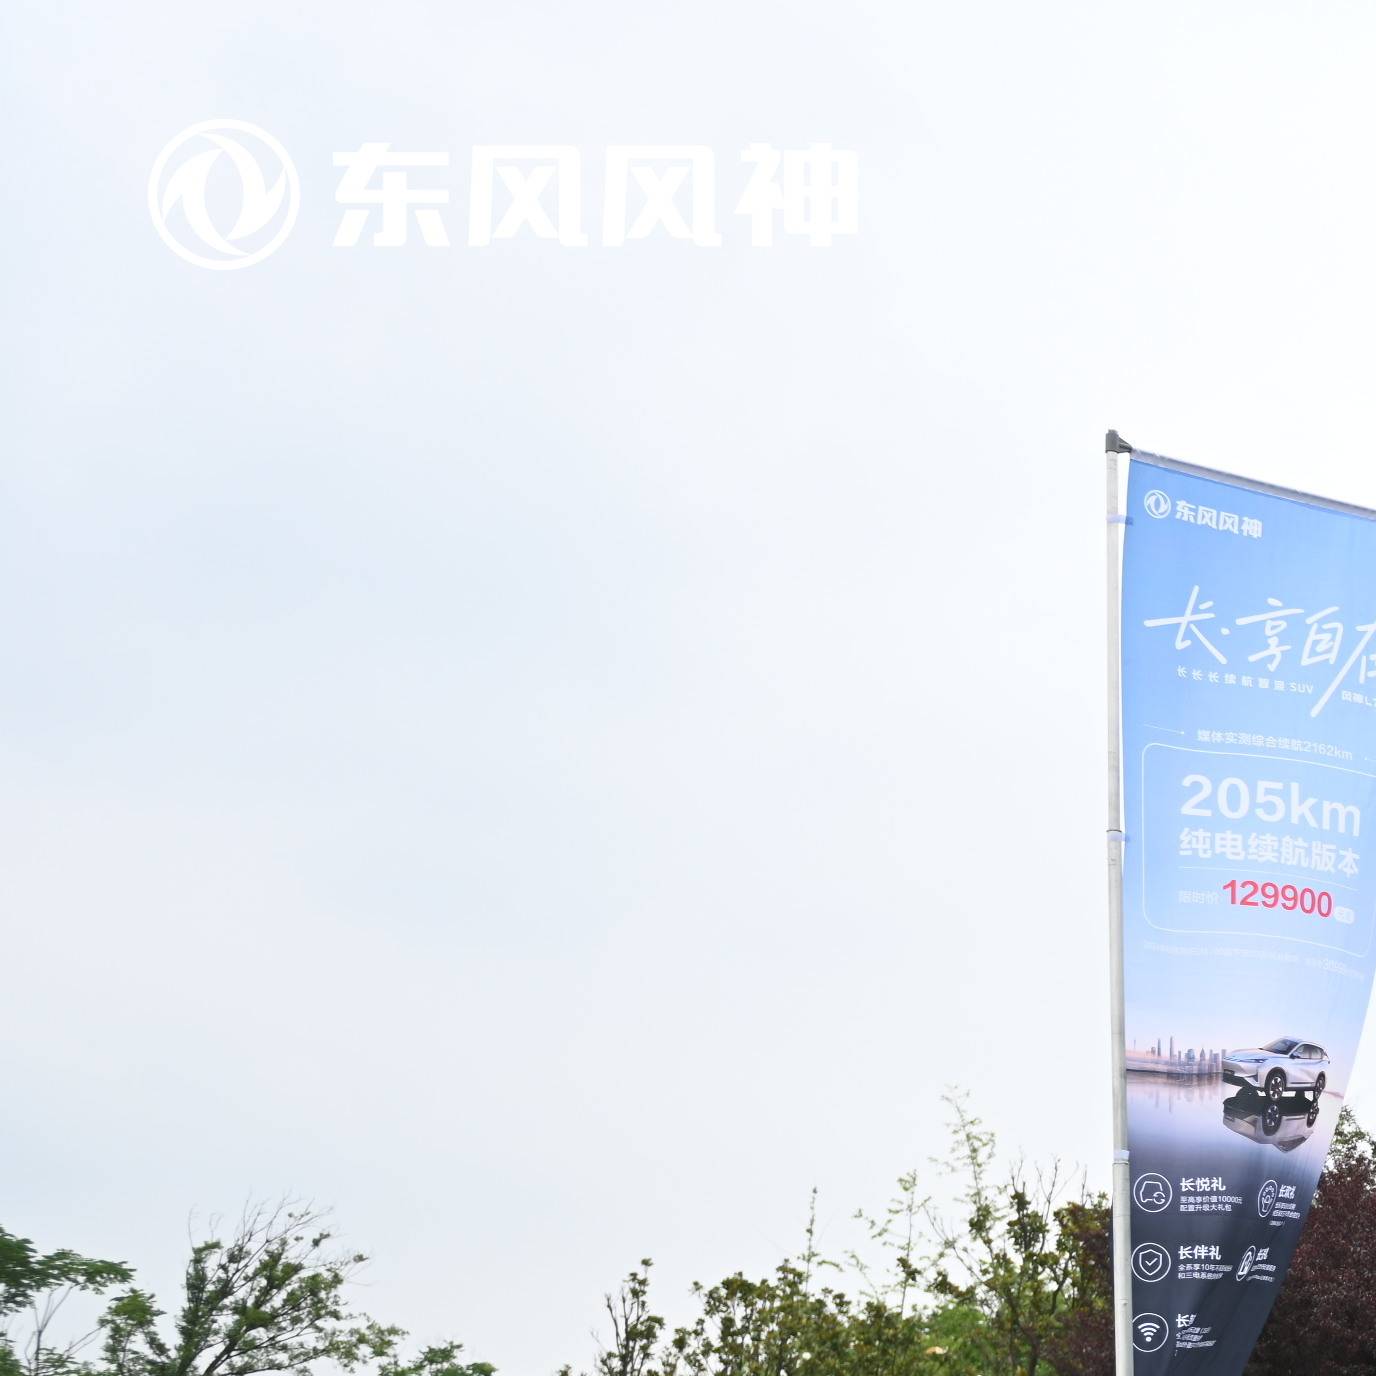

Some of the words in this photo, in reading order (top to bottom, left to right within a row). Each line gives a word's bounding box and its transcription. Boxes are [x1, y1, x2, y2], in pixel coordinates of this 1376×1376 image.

[1175, 499, 1262, 539] 东风风神
[1180, 774, 1362, 837] 205km
[1178, 828, 1361, 879] 纯电续航版本
[1222, 879, 1334, 918] 129900
[1180, 1177, 1227, 1192] 长悦礼
[1178, 1244, 1222, 1261] 长伴礼
